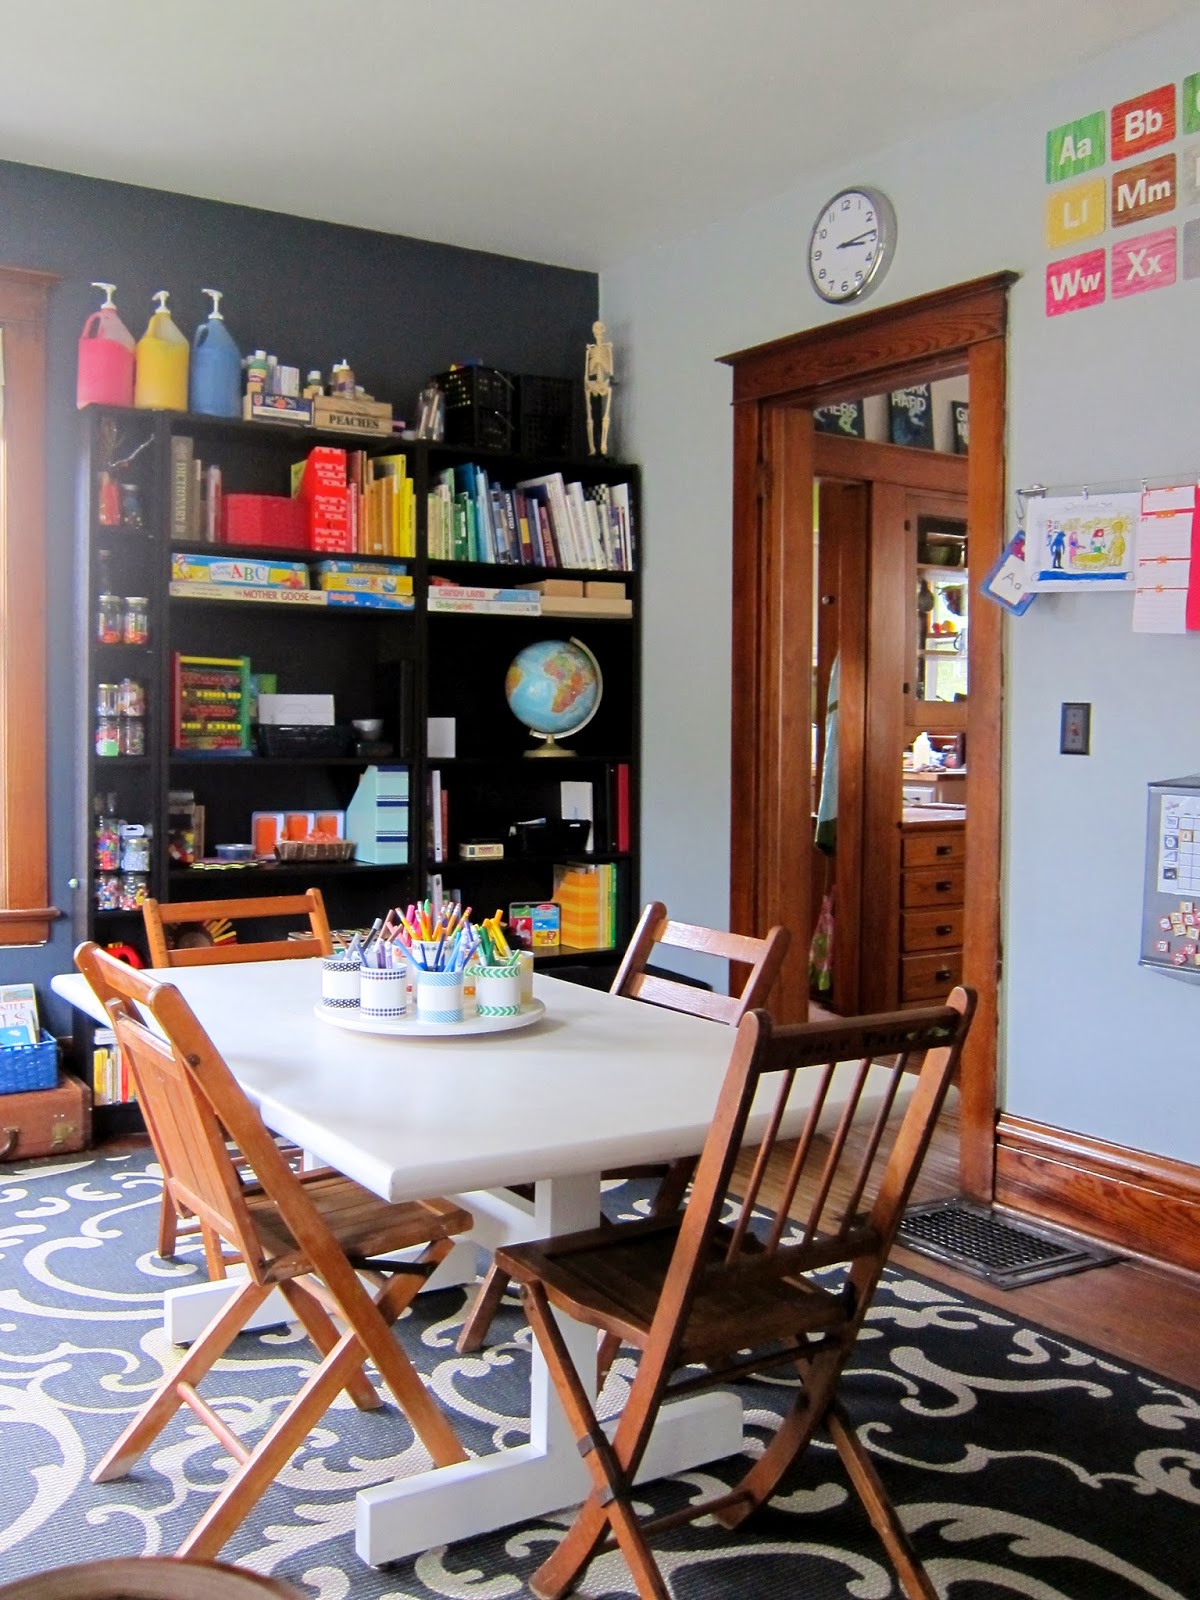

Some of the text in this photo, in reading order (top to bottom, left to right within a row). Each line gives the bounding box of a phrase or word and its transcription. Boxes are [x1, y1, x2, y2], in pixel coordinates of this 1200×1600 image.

[1124, 109, 1164, 143] Bb
[1059, 135, 1092, 166] Aa
[1117, 178, 1171, 212] Mm
[1127, 249, 1163, 281] Xx
[1050, 269, 1102, 302] Ww
[329, 414, 380, 430] PEACHES
[175, 462, 187, 523] DICTIONARY
[231, 564, 266, 582] ABC
[243, 589, 278, 600] MOTHER
[281, 591, 310, 602] GOOSE
